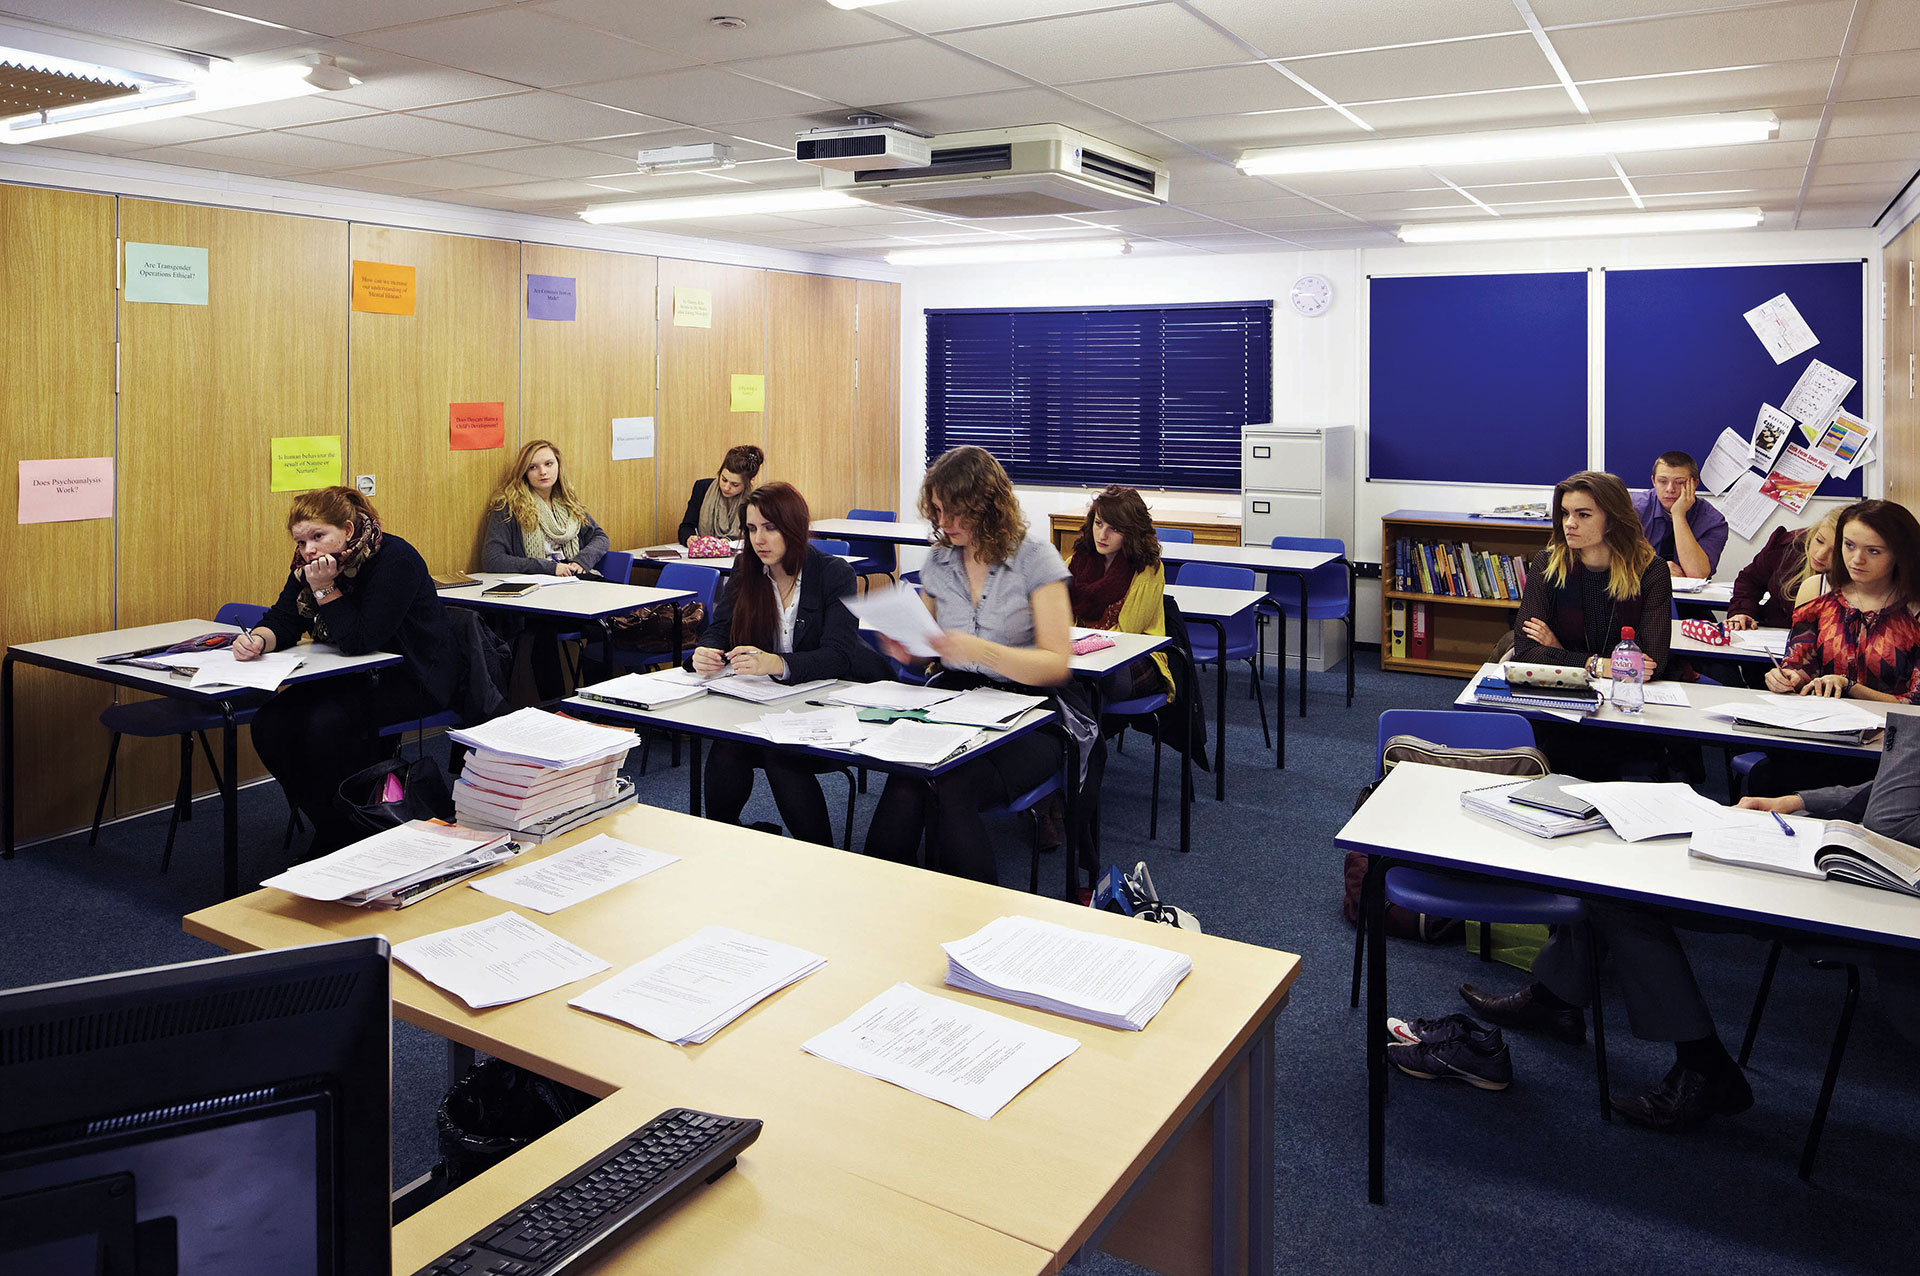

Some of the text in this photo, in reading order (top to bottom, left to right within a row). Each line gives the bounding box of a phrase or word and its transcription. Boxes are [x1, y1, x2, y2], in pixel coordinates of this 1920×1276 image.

[157, 262, 192, 271] Transgender
[139, 269, 196, 279] Operations Ethical?
[370, 284, 402, 293] understanding
[471, 422, 499, 430] Development?
[33, 476, 102, 487] Does Psychoanalysis
[56, 486, 79, 494] Work?
